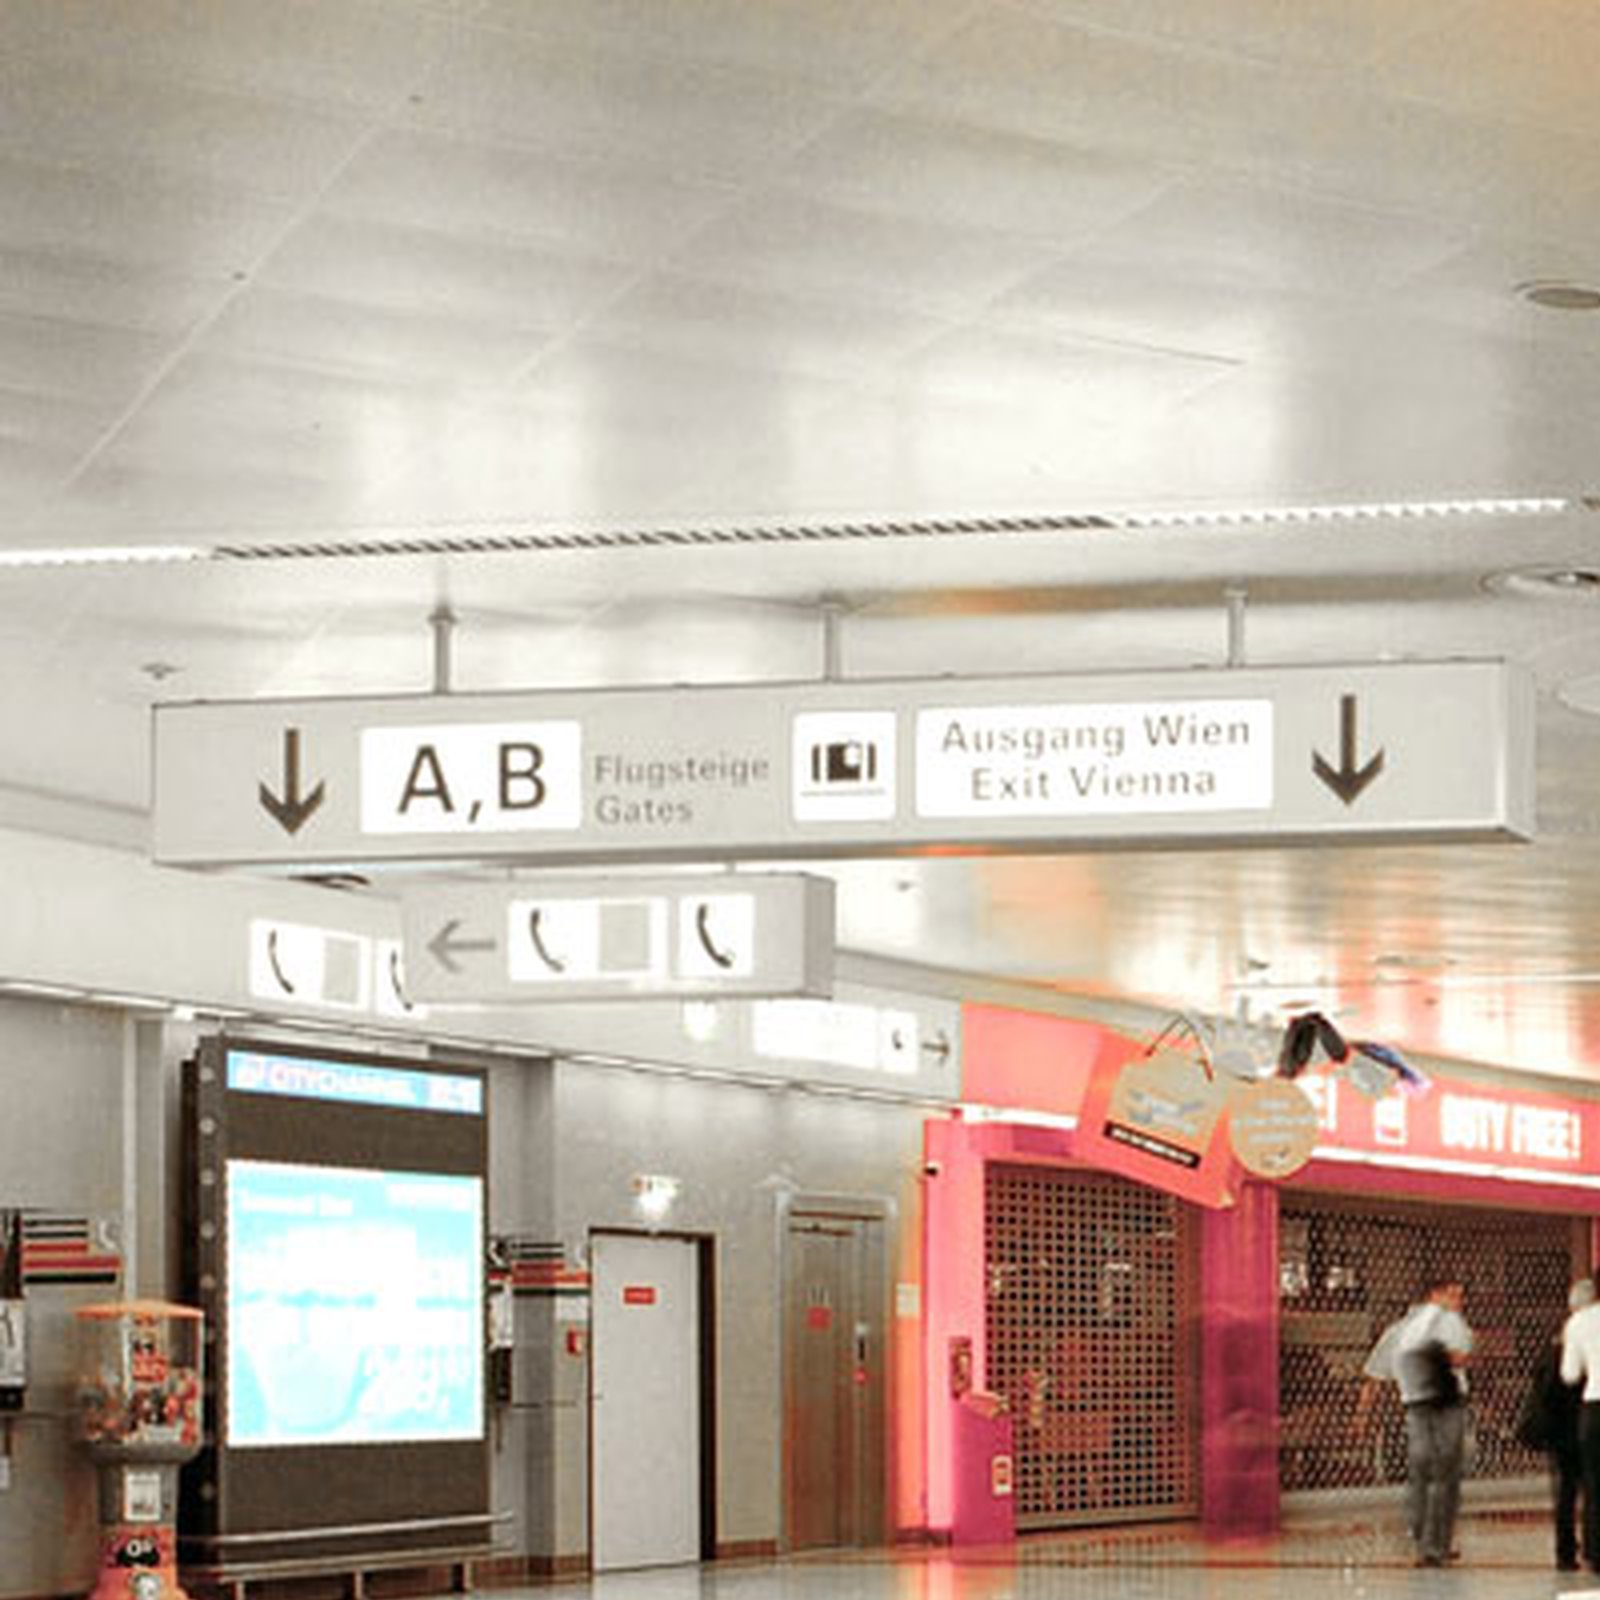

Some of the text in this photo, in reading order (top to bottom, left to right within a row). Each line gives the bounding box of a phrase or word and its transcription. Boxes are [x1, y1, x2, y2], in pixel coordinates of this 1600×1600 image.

[941, 715, 1251, 757] Ausgang Wien
[397, 741, 548, 824] A,B
[593, 754, 771, 786] Flugsteige
[970, 763, 1216, 802] Exit Vienna
[594, 794, 694, 825] Gates
